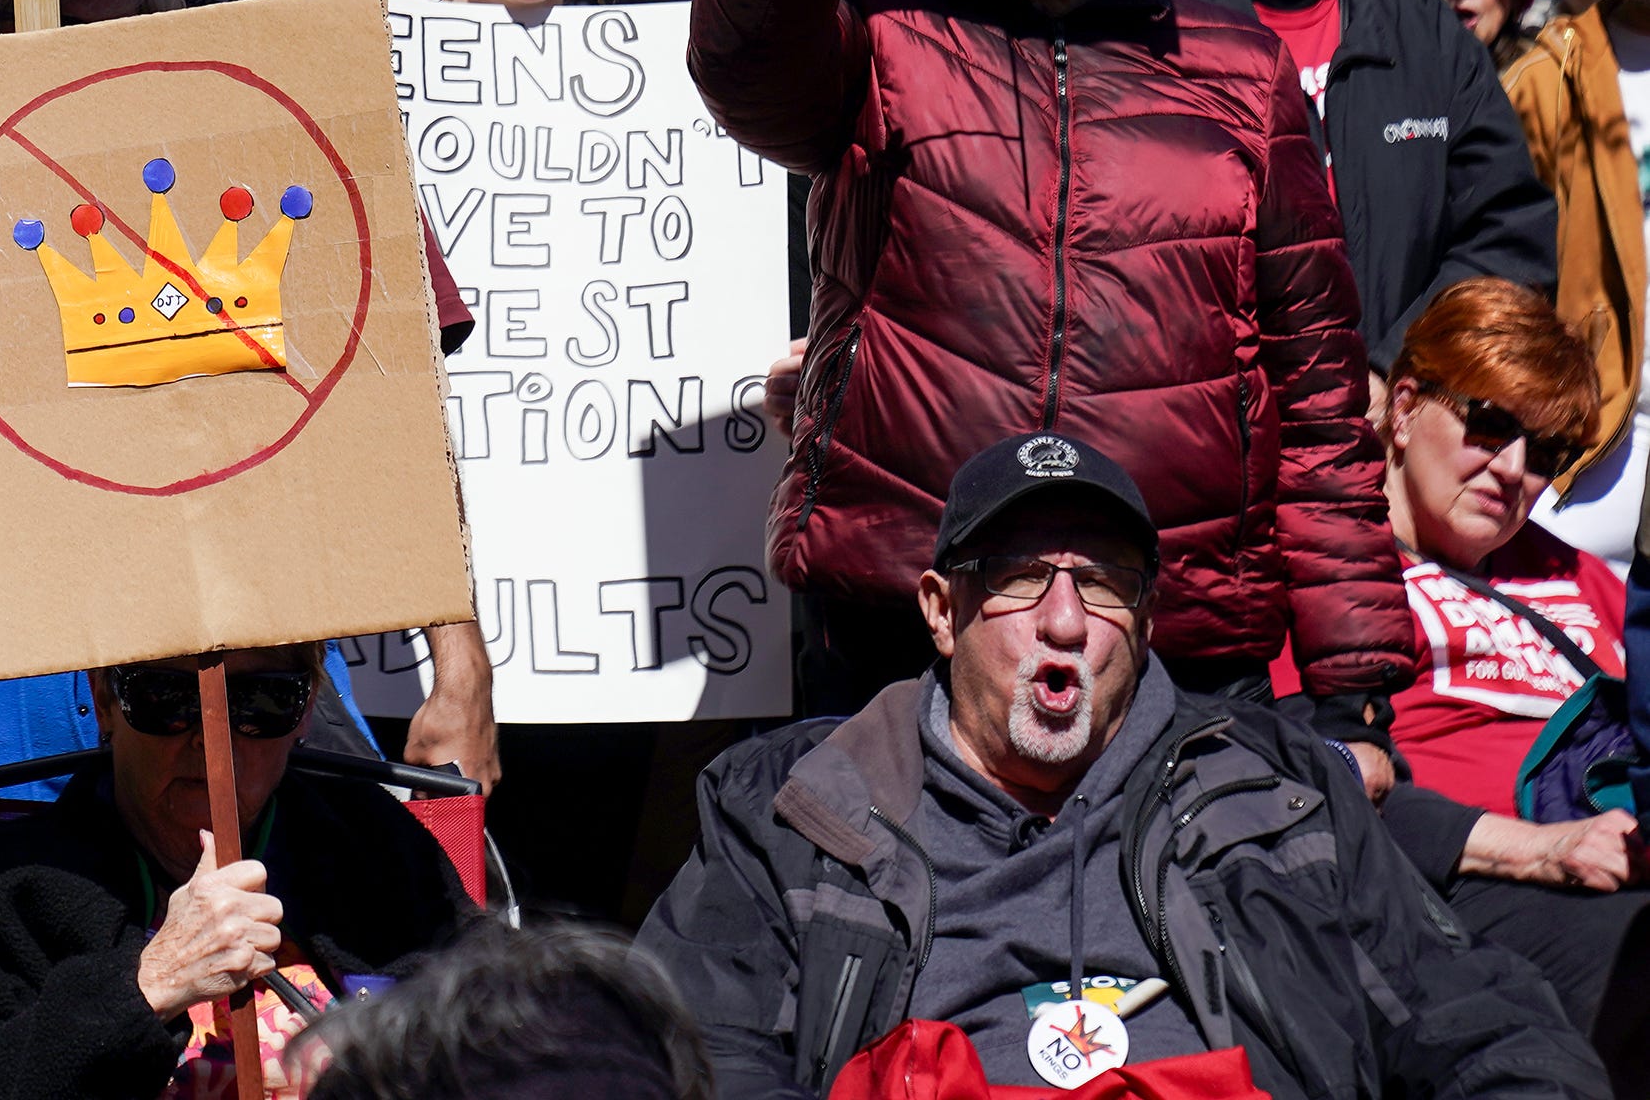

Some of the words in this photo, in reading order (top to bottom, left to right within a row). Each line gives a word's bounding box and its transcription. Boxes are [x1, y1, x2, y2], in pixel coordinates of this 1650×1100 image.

[581, 194, 693, 266] TO
[157, 294, 183, 308] DJT
[1464, 659, 1500, 681] FOR
[1047, 1036, 1082, 1071] NO
